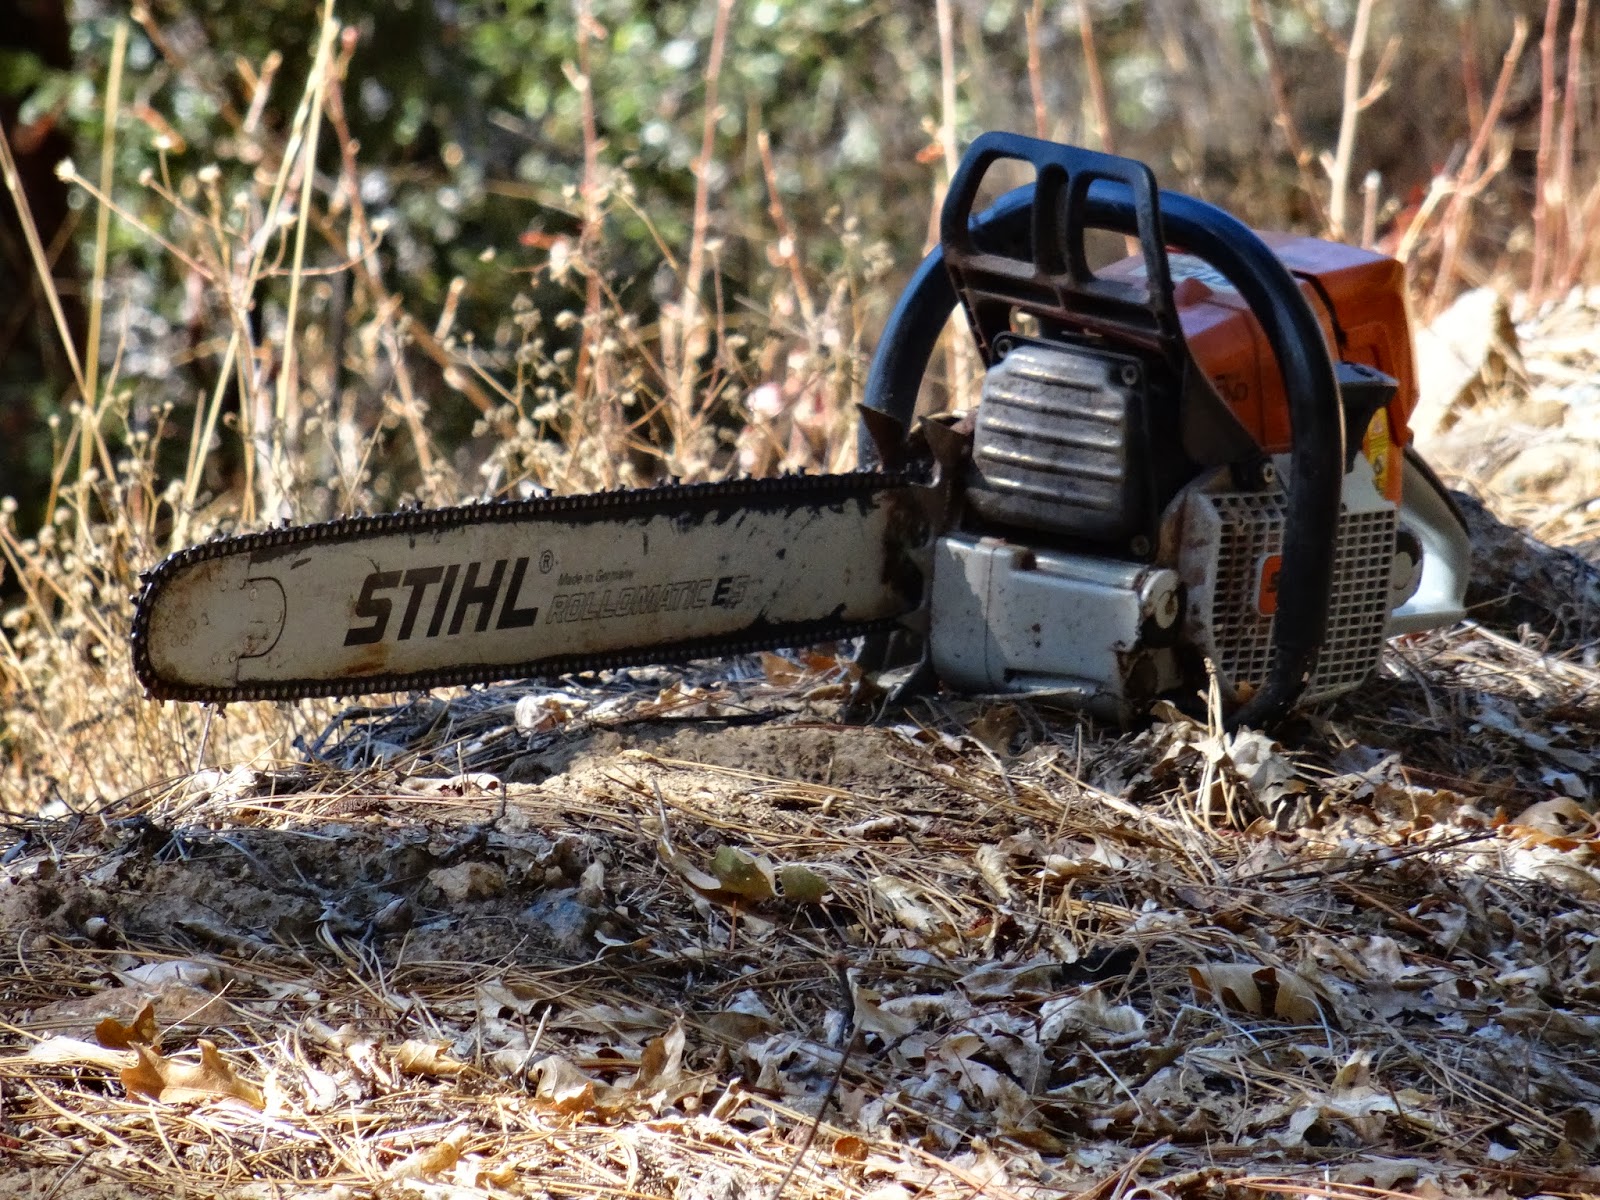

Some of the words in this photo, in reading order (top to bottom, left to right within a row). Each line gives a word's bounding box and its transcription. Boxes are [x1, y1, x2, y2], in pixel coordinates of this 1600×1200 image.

[344, 557, 538, 646] STIHL
[544, 579, 713, 625] ROLLOMATIC
[557, 573, 583, 586] Made
